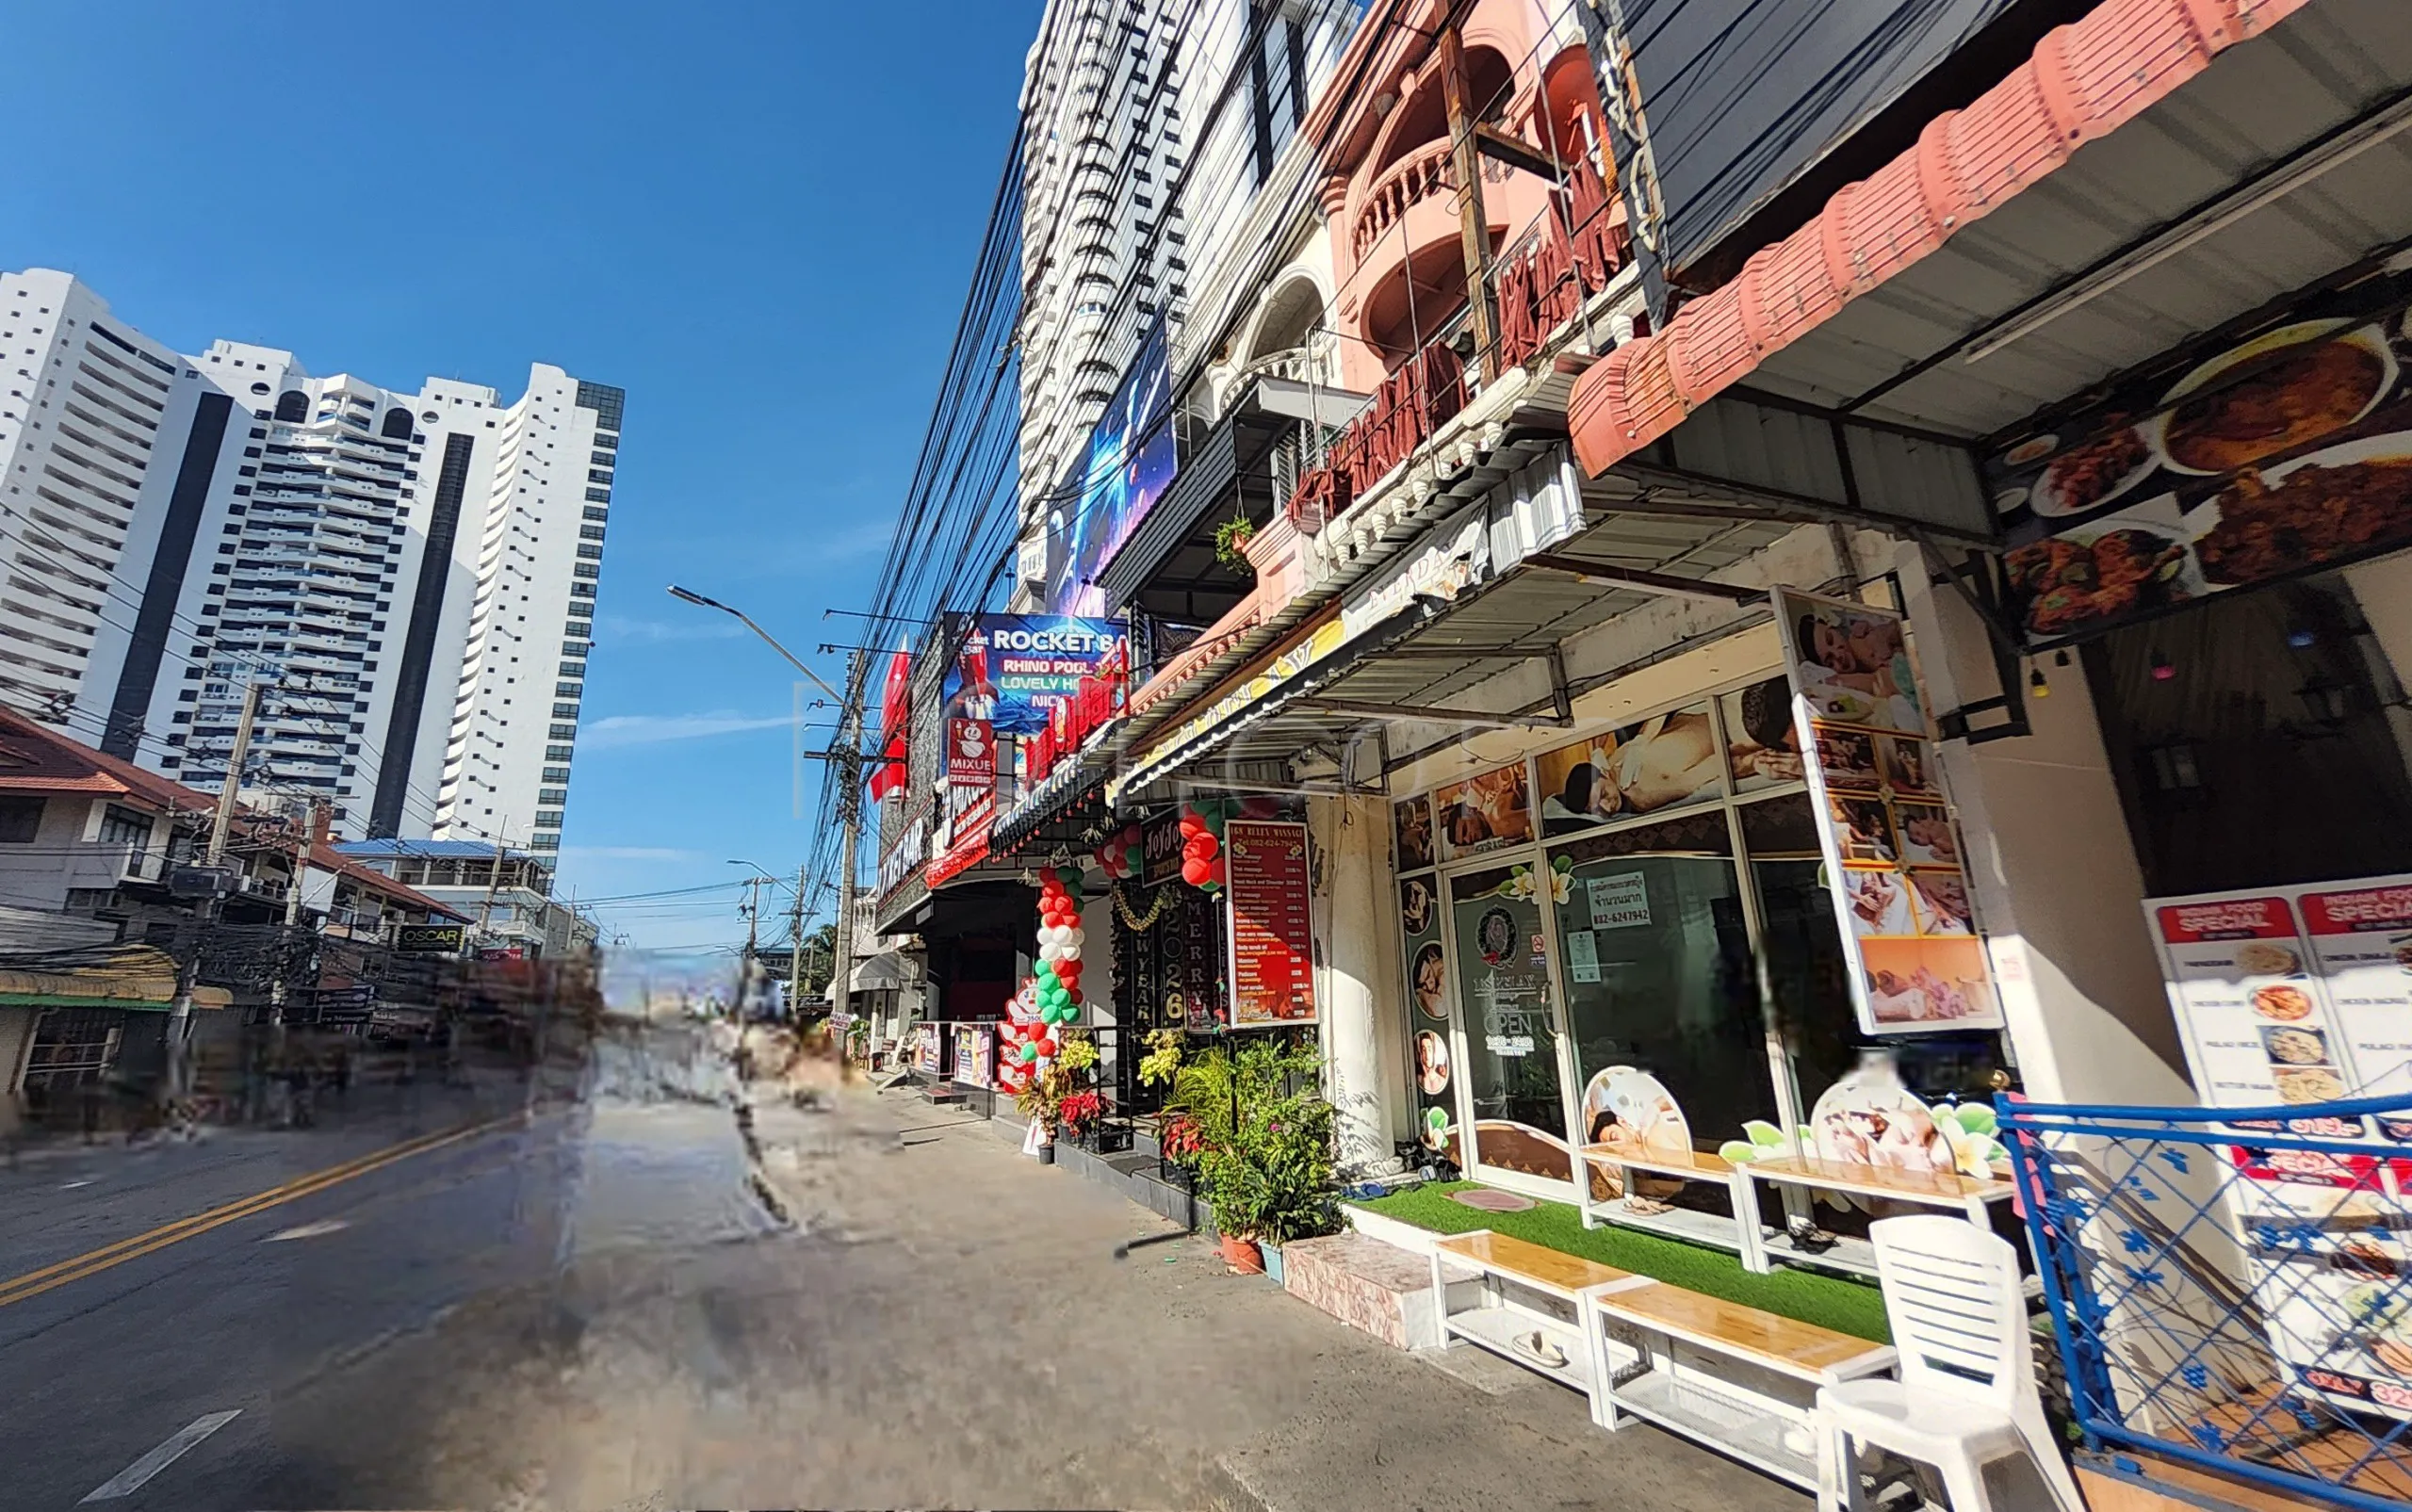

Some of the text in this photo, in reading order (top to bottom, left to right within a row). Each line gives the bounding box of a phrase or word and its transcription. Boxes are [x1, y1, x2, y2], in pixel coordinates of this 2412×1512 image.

[994, 630, 1130, 653] ROCKET BA
[1003, 659, 1050, 674] RHINO
[1053, 661, 1093, 675] POOL
[1001, 676, 1058, 691] LOVELY
[1032, 695, 1059, 707] NIC
[950, 758, 992, 771] MIXUE
[2178, 914, 2273, 932] SPECIAL
[403, 930, 459, 942] OSCAR
[1484, 1012, 1534, 1035] OPEN
